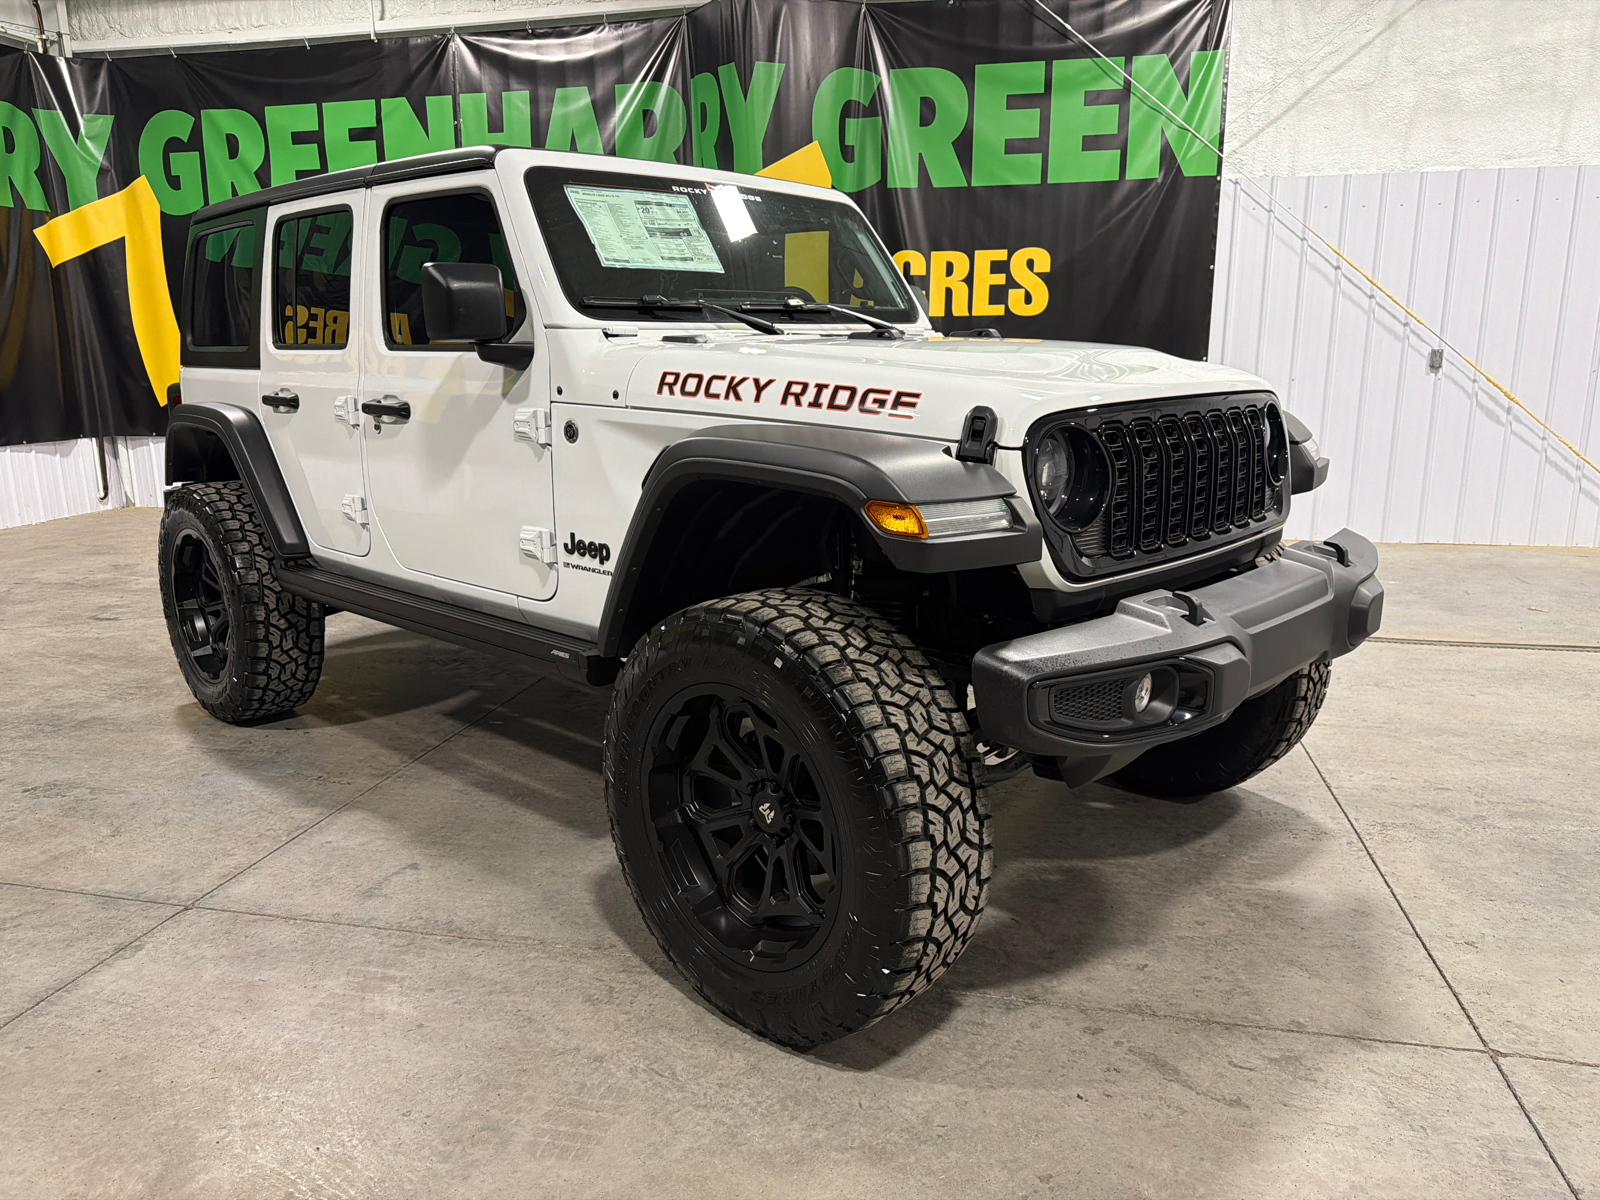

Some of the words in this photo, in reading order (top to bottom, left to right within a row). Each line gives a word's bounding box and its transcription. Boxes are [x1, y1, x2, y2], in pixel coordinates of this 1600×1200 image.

[459, 61, 786, 173] HARRY
[812, 49, 1225, 193] GREEN
[138, 95, 456, 216] GREEN
[671, 185, 708, 195] ROCKY
[656, 371, 776, 403] ROCKY
[780, 380, 922, 419] RIDGE
[563, 532, 611, 565] Jeep
[570, 562, 613, 577] WRANGLER
